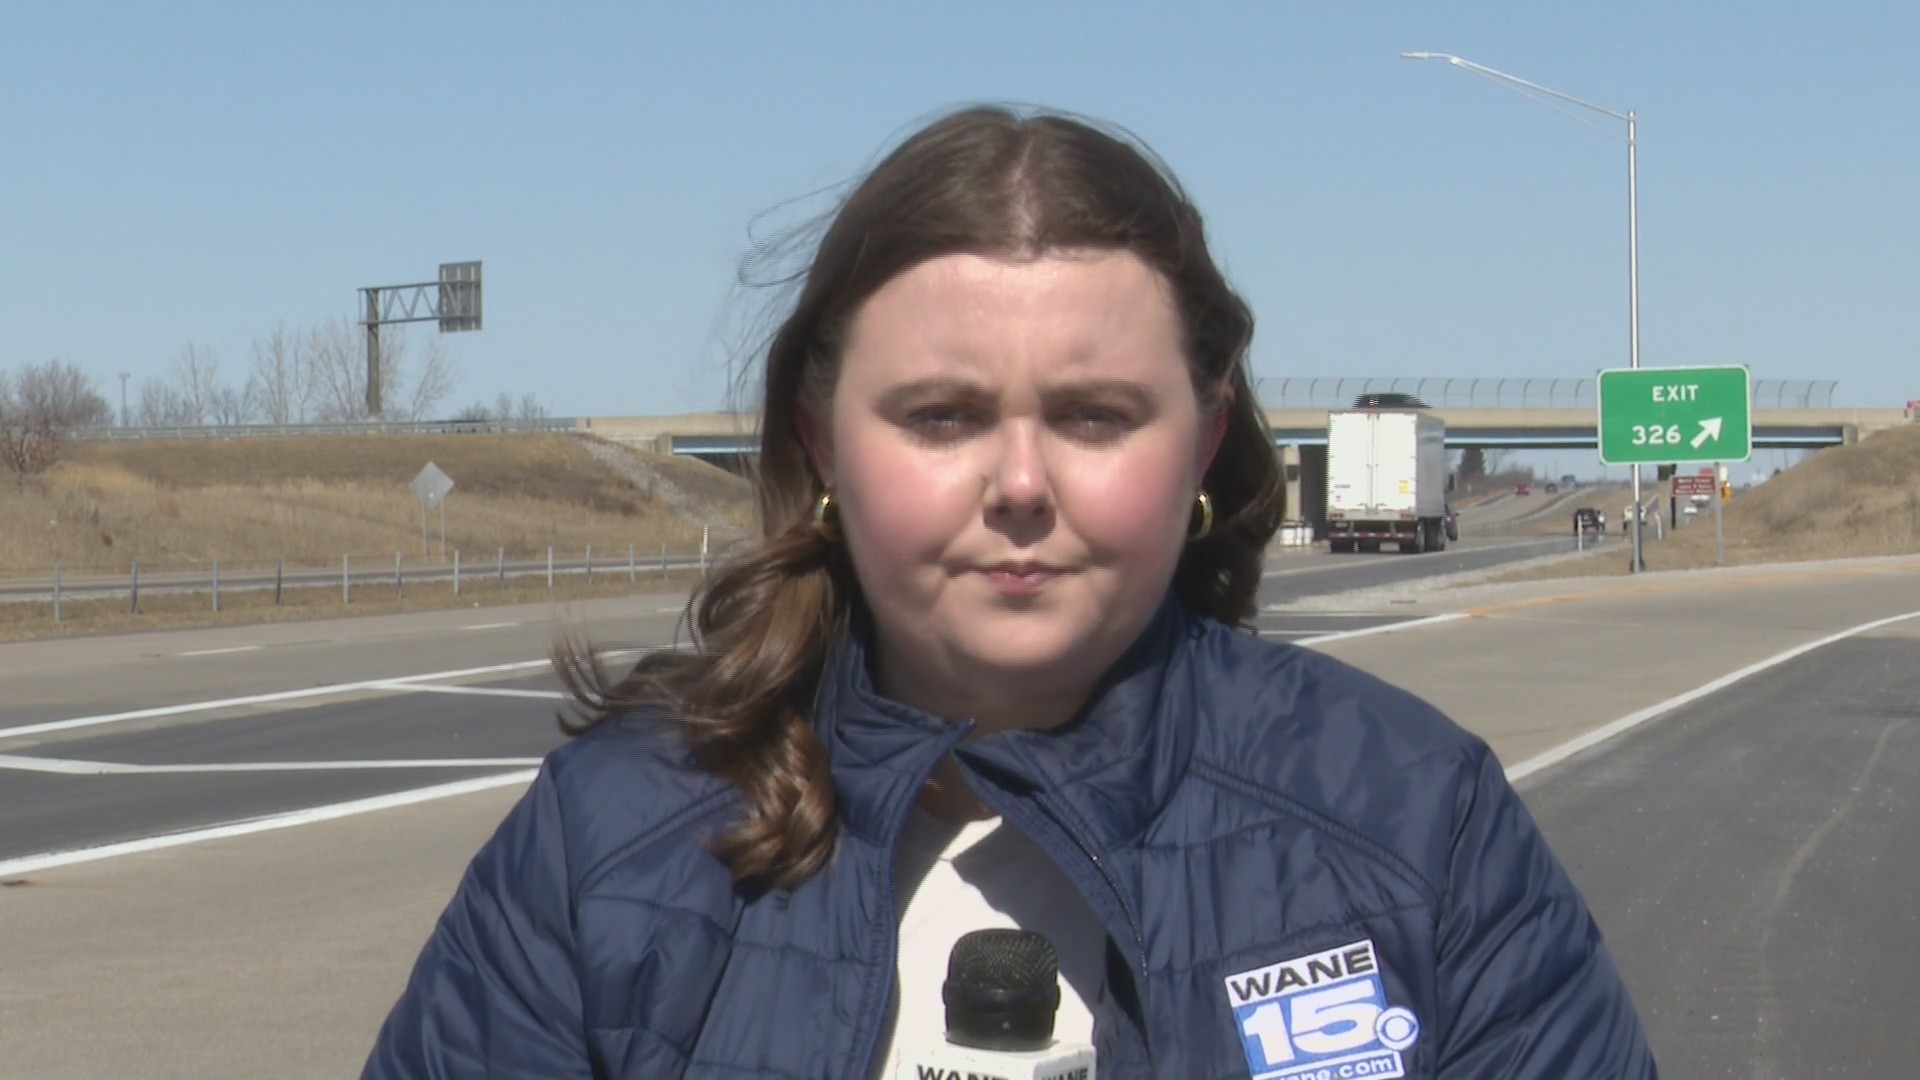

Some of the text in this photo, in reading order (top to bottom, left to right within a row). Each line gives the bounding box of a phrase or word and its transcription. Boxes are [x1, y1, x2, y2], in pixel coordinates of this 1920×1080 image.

[1652, 384, 1699, 402] EXIT
[1632, 425, 1682, 445] 326
[1230, 943, 1375, 1001] WANE
[1242, 979, 1385, 1066] 15
